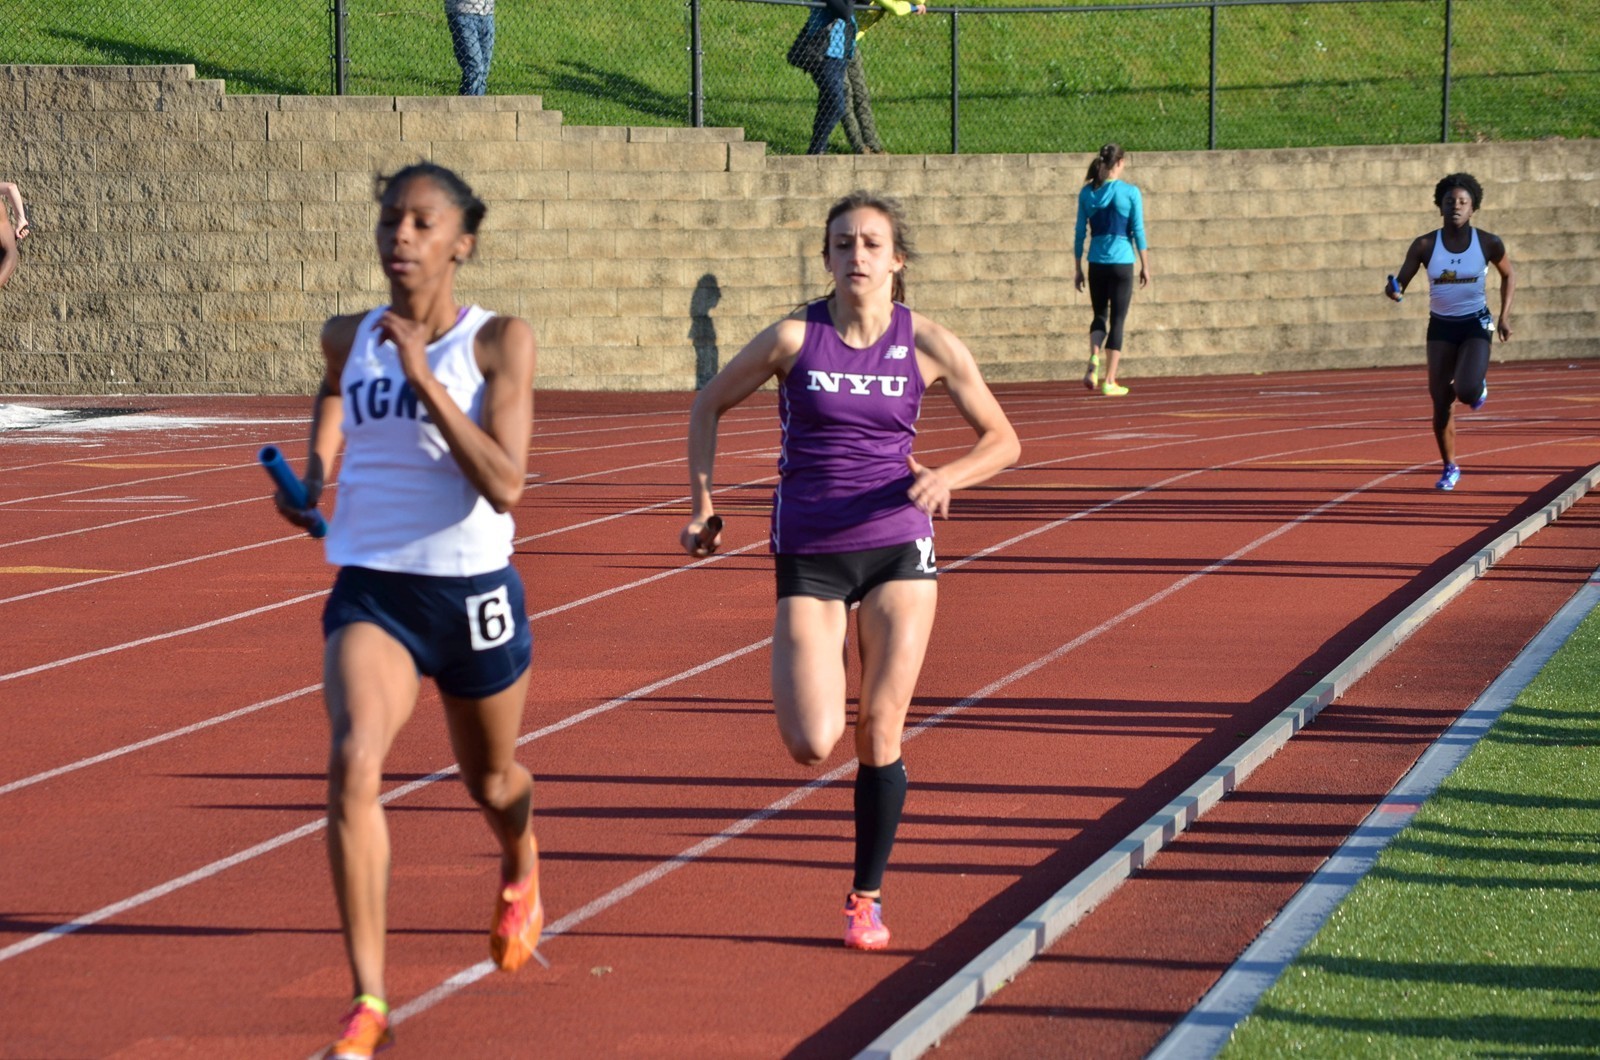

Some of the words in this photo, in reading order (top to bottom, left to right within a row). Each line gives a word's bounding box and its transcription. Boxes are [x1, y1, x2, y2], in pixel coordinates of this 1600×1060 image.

[347, 377, 434, 426] TCN
[806, 370, 909, 397] NYU
[478, 597, 507, 641] 6
